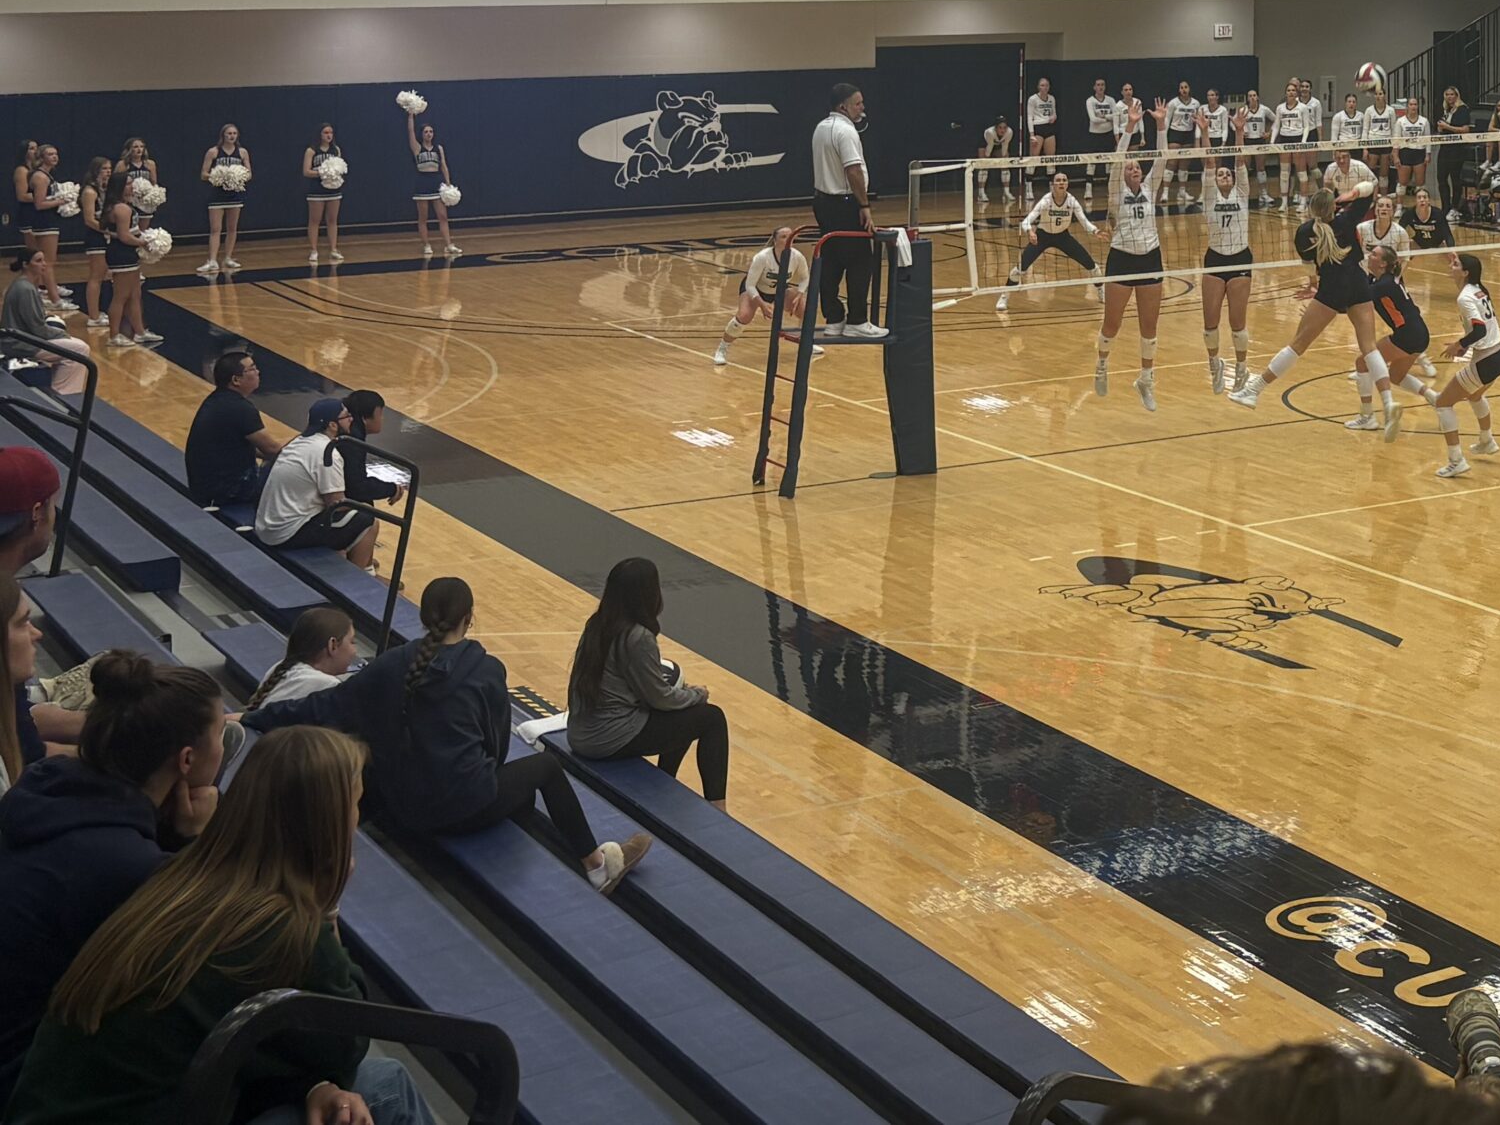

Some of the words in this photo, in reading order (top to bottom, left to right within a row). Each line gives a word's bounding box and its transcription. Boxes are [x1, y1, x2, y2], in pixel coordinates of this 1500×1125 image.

[1040, 154, 1081, 164] CONCORDIA
[1125, 150, 1163, 159] CONCORDIA
[1205, 146, 1243, 155] CONCORDIA
[1283, 142, 1319, 151] CONCORDIA
[1358, 138, 1391, 146] CONCORDIA
[1430, 134, 1463, 142] CONCORDIA
[1132, 206, 1145, 219] 16
[1055, 218, 1061, 226] 6
[1221, 215, 1232, 227] 17
